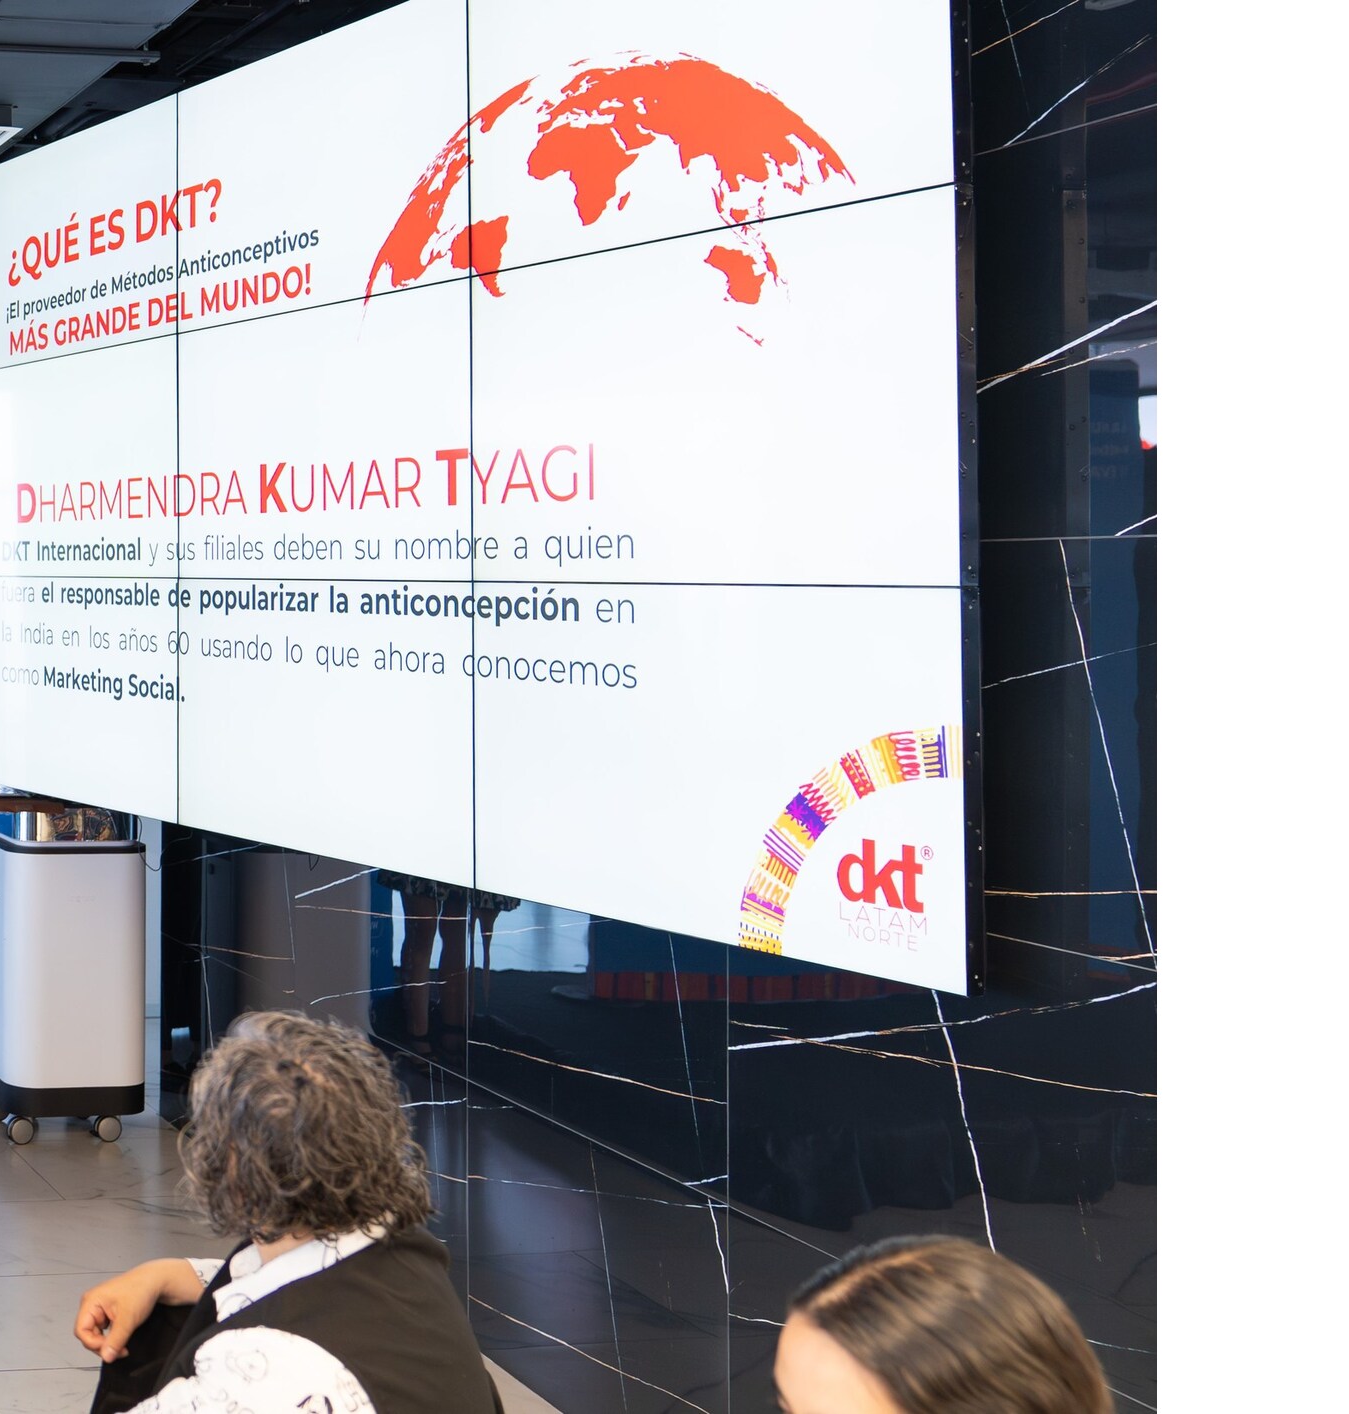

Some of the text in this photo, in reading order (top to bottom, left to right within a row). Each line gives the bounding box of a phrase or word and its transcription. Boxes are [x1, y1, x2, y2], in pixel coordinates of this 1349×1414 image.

[8, 178, 222, 287] ¿QUÉ ES DKT?
[6, 228, 319, 324] ¡El proveedor de Métodos Anticonceptivos
[10, 263, 311, 356] MÁS GRANDE DEL MUNDO!
[17, 443, 594, 523] DHARMENDRA KUMAR TYAGI
[2, 526, 635, 567] DKT Internacional y sus filiales deben su nombre a quien
[2, 580, 635, 627] fuera el responsable de popularizar la anticoncepción en
[2, 620, 638, 689] la India en los años 60 usando lo que ahora conocemos
[2, 665, 186, 702] como Marketing Social.
[839, 901, 928, 936] LATAM
[847, 923, 918, 952] NORTE
